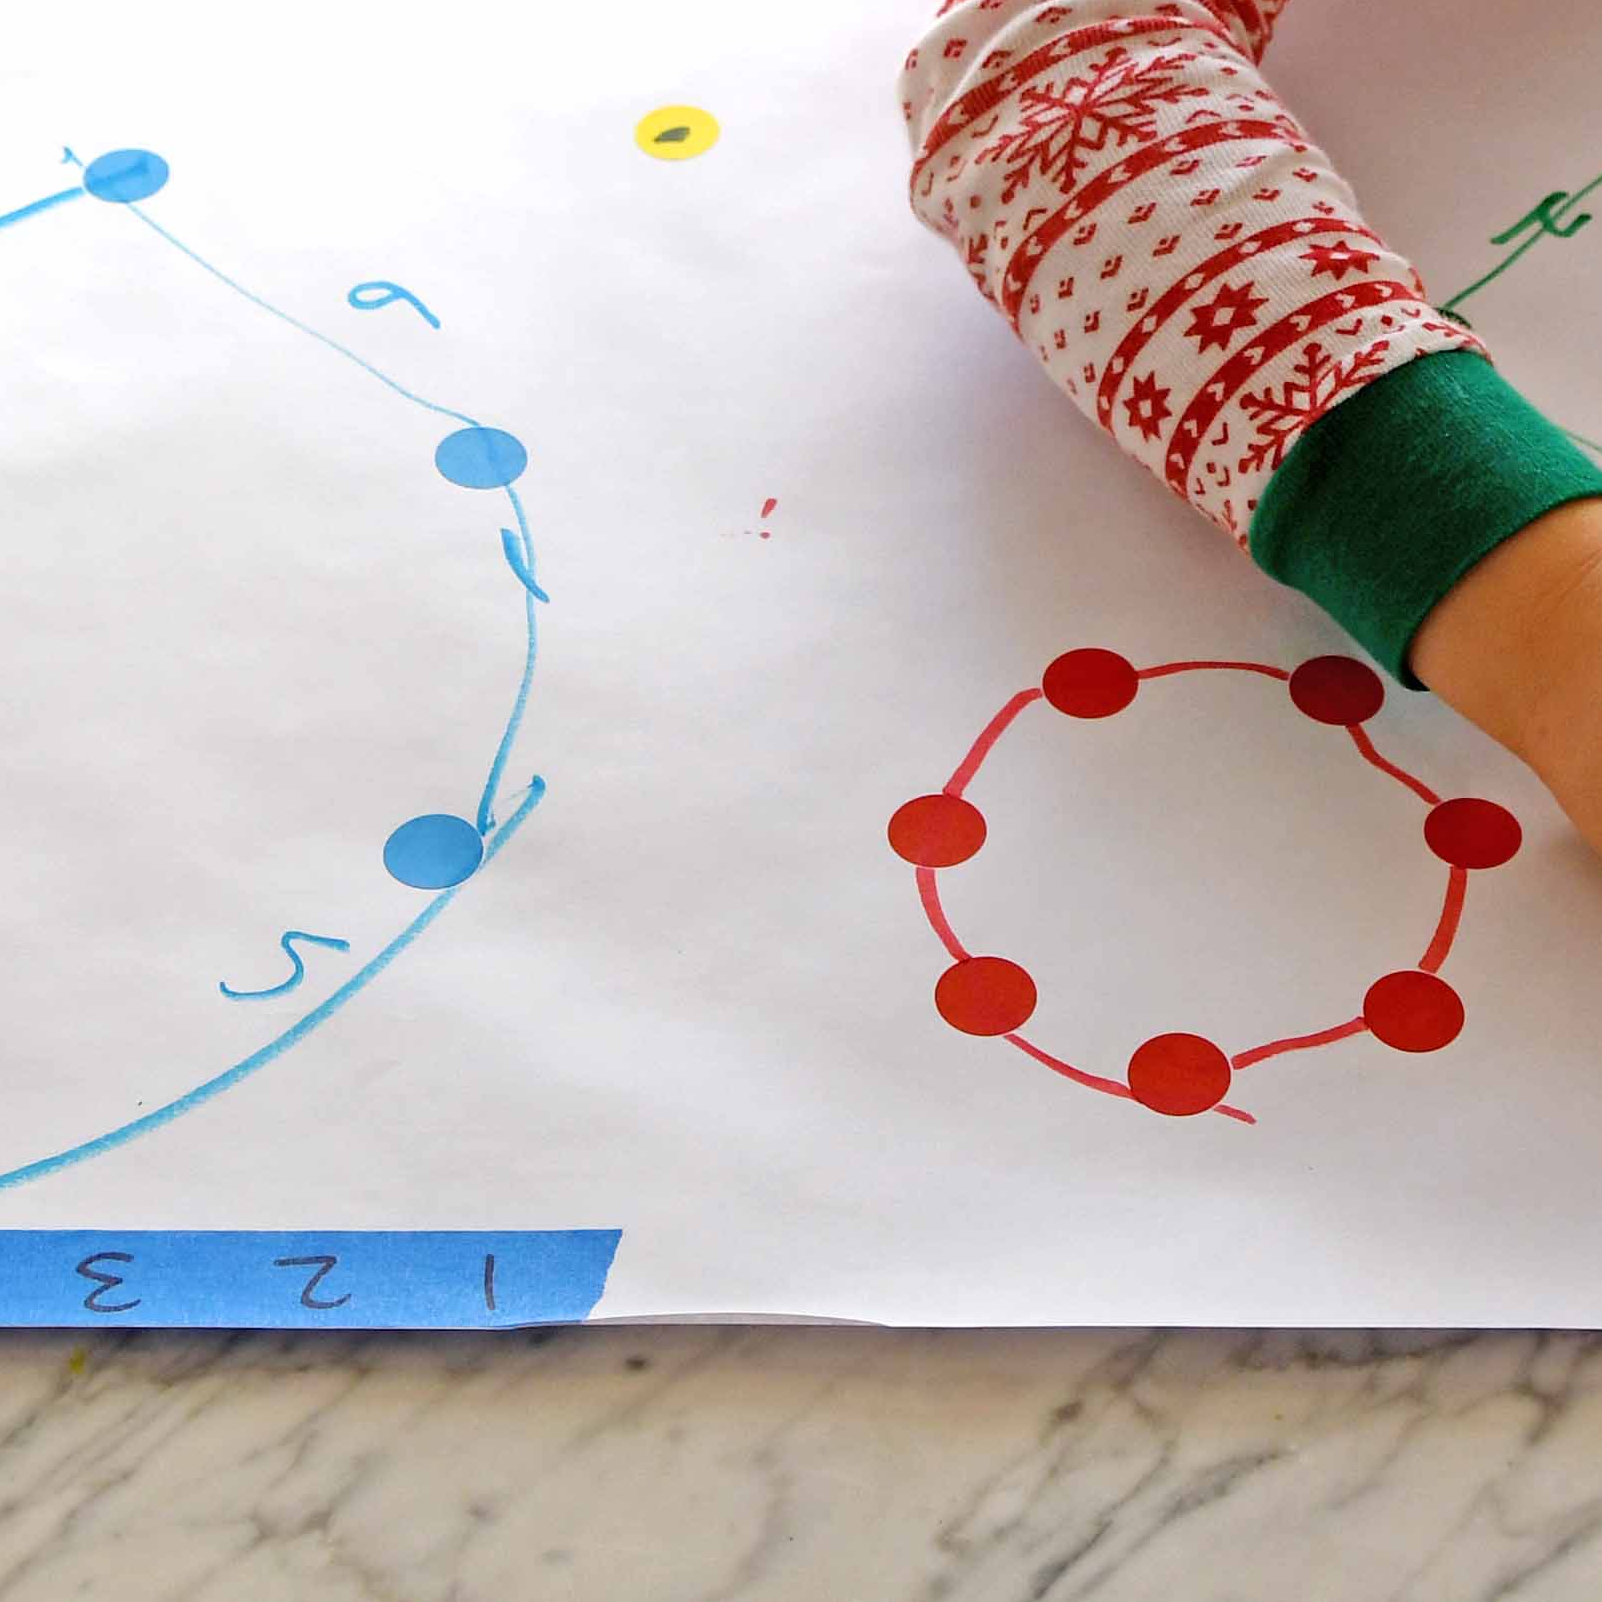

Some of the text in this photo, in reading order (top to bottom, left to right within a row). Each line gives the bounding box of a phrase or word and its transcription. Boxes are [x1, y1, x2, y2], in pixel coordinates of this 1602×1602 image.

[76, 1252, 140, 1312] 3
[278, 1255, 350, 1308] 2
[483, 1254, 496, 1304] 1
